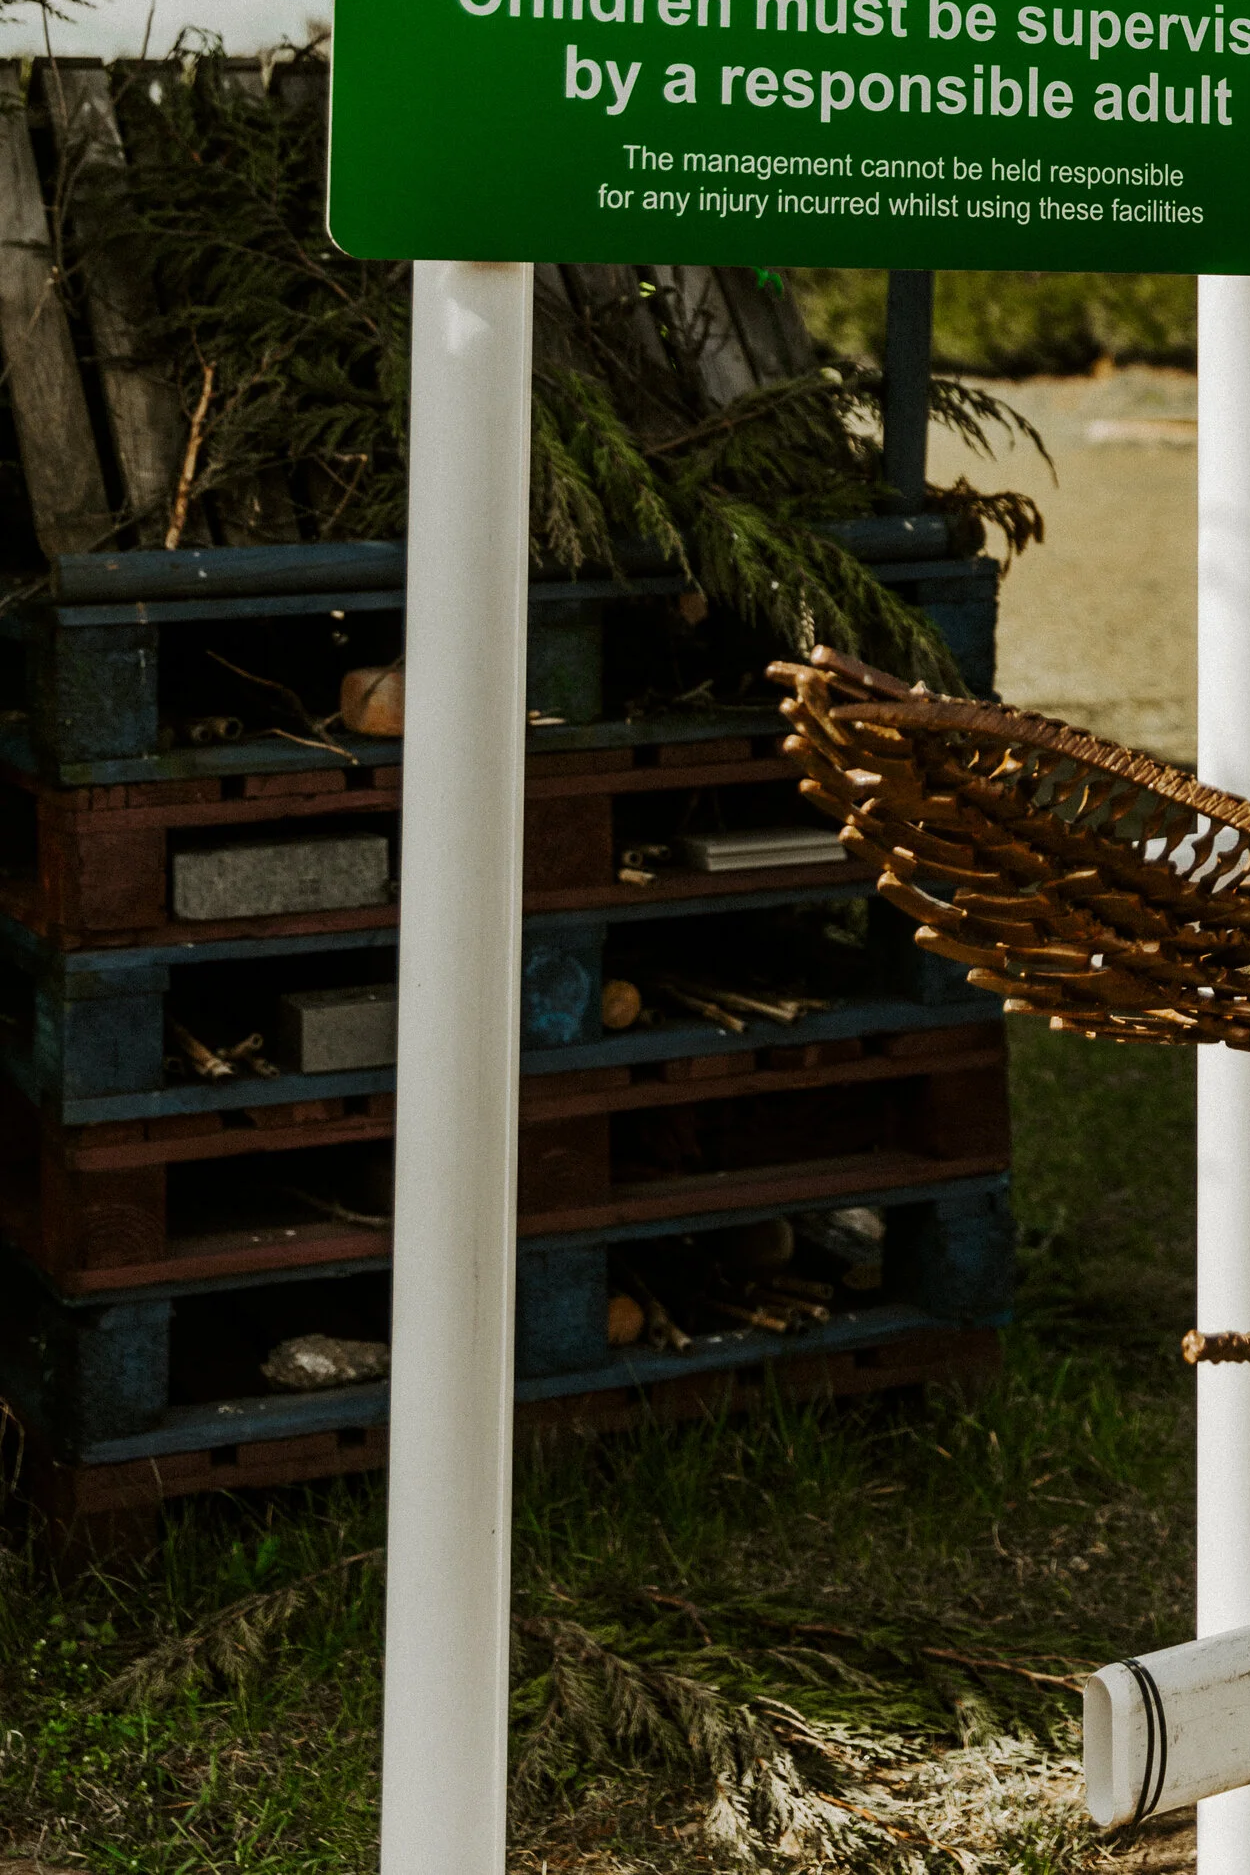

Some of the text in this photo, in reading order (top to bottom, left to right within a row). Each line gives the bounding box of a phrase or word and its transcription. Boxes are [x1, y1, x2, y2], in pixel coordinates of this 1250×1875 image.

[565, 43, 1233, 126] by a responsible adult
[622, 144, 1184, 190] The management cannot be held responsible
[597, 182, 1204, 226] for any injury incurred whilst using these facilities
